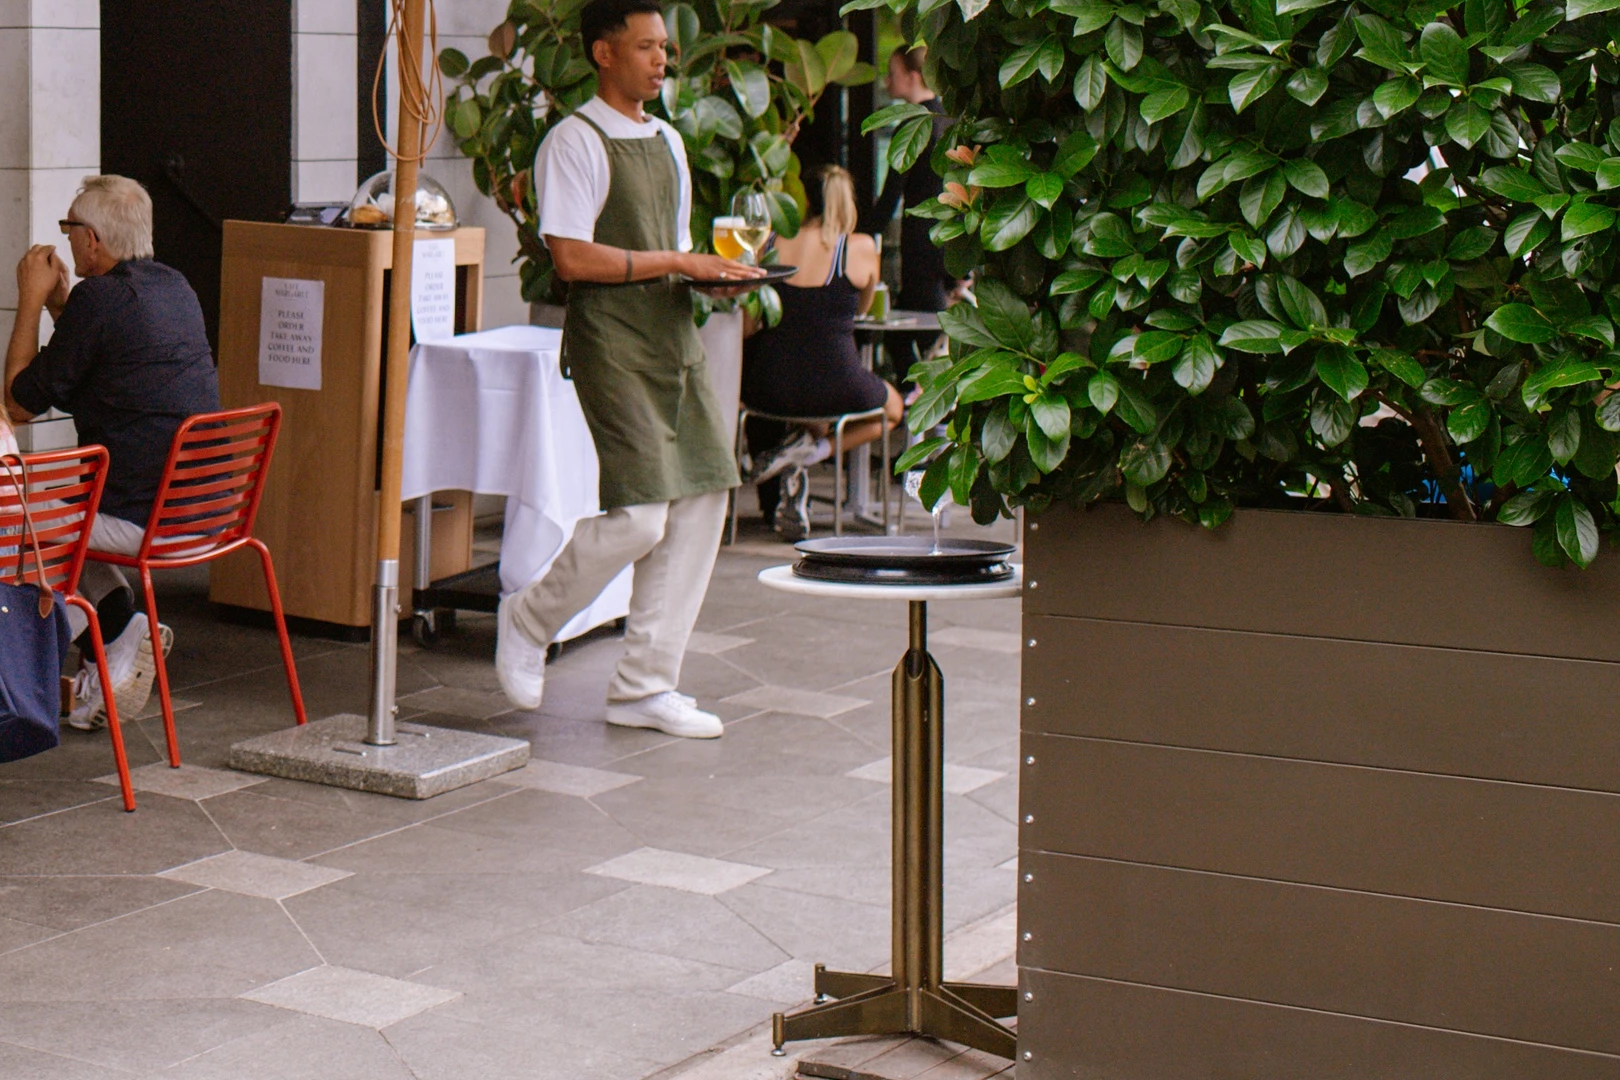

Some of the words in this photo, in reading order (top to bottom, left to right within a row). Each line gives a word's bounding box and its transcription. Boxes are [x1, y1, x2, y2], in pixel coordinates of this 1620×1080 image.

[278, 310, 305, 320] PLEASE
[278, 321, 305, 331] ORDER
[270, 331, 287, 340] TAKE
[290, 333, 312, 342] AWAY
[267, 343, 294, 353] COFFEE
[298, 345, 315, 354] AND
[268, 354, 291, 364] FOOD
[291, 356, 311, 366] HERE
